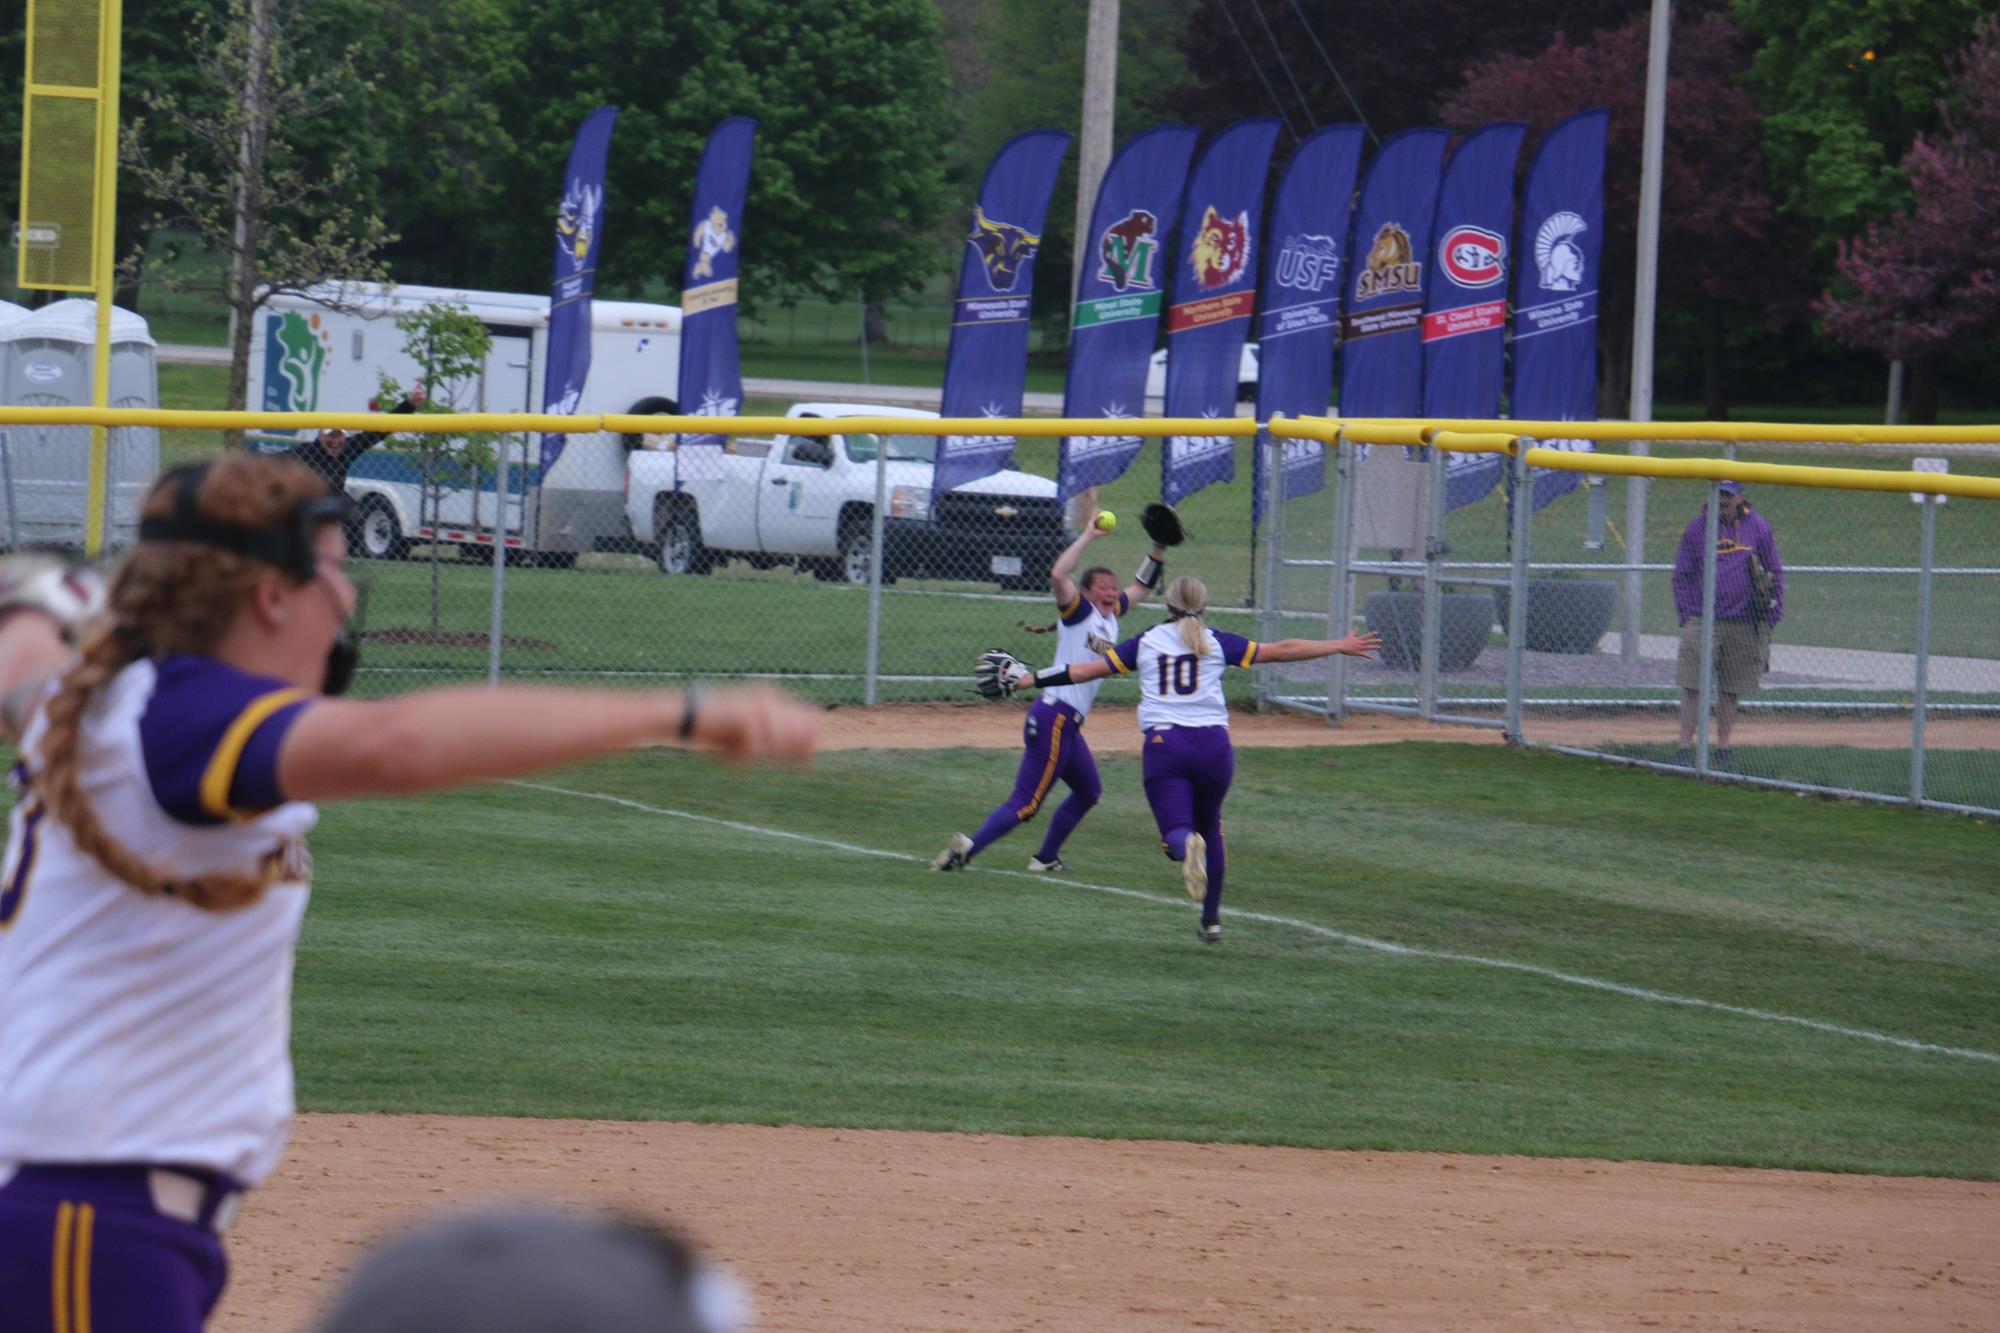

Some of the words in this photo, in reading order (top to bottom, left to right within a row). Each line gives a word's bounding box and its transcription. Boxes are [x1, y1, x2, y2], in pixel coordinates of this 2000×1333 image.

[1275, 249, 1339, 292] USF
[1356, 262, 1422, 302] SMSU
[1157, 652, 1199, 696] 10
